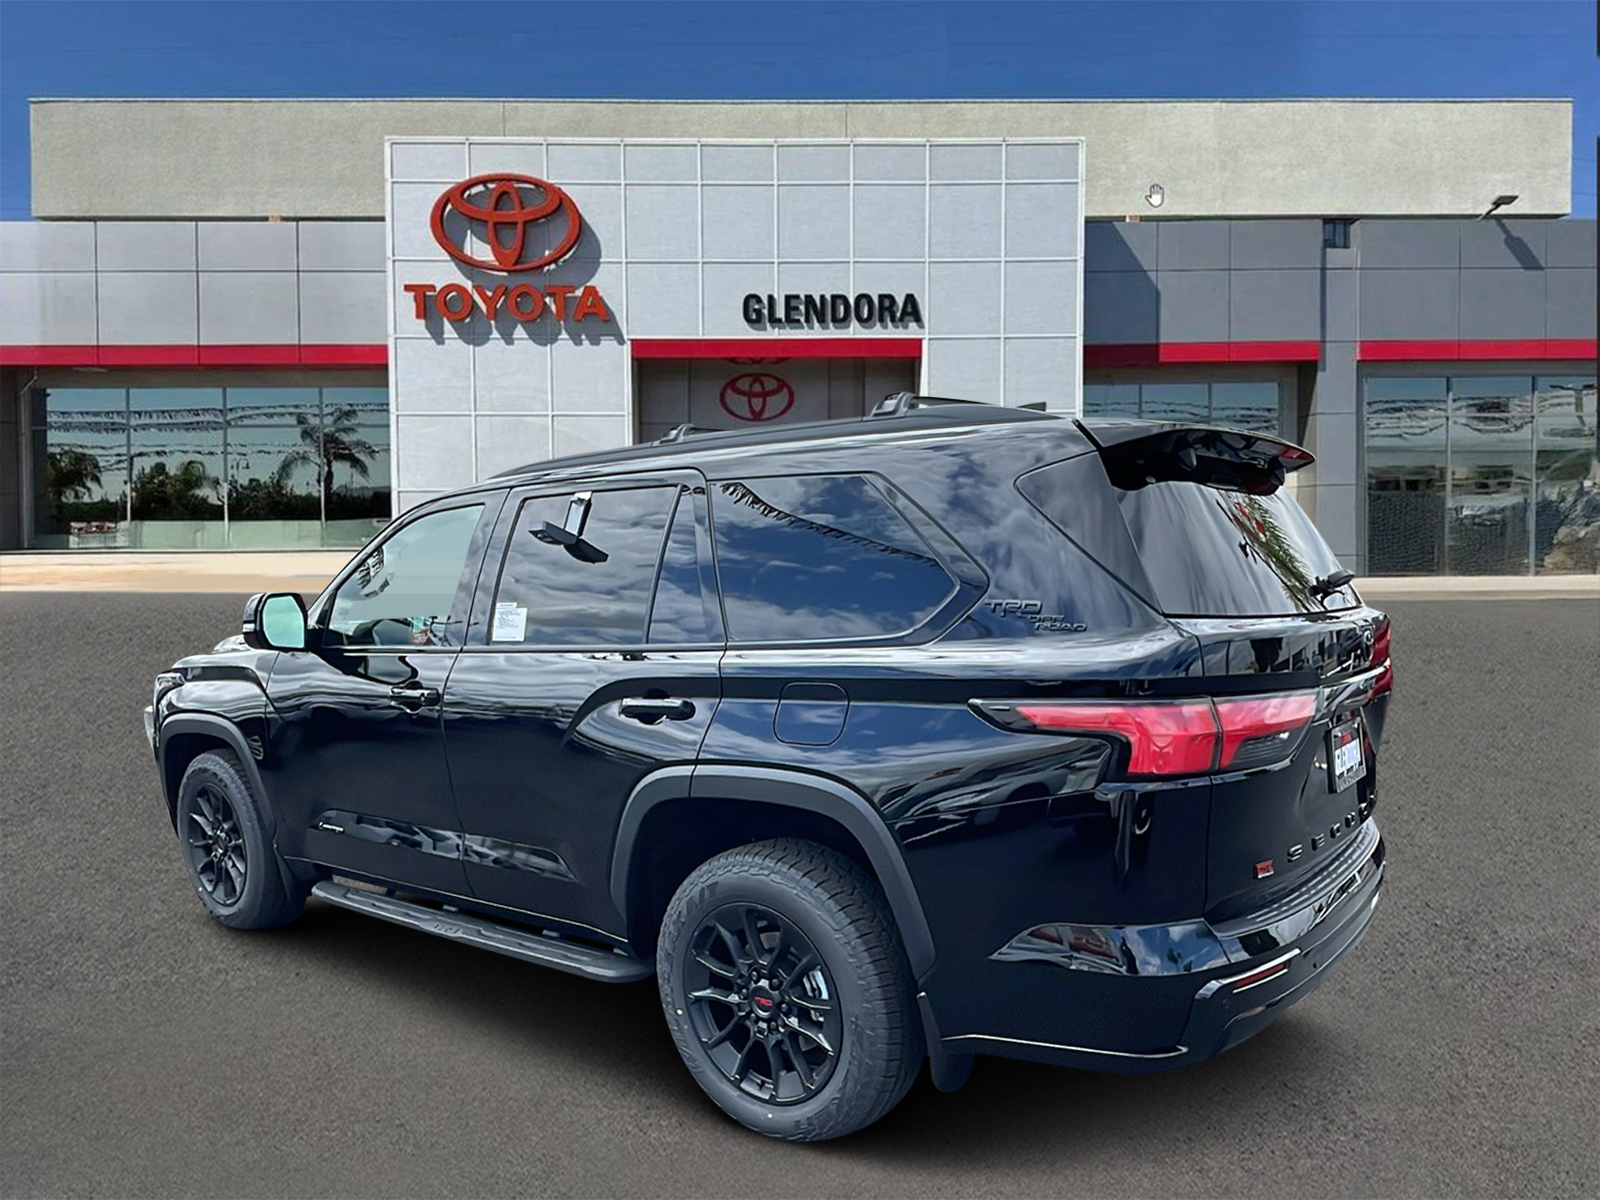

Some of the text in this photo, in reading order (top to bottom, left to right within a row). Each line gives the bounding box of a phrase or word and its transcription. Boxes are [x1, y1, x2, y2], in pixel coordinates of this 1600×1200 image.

[404, 283, 610, 322] TOYOTA
[742, 293, 922, 326] GLENDORA
[985, 599, 1043, 618] TRD
[1034, 622, 1088, 632] ROAD
